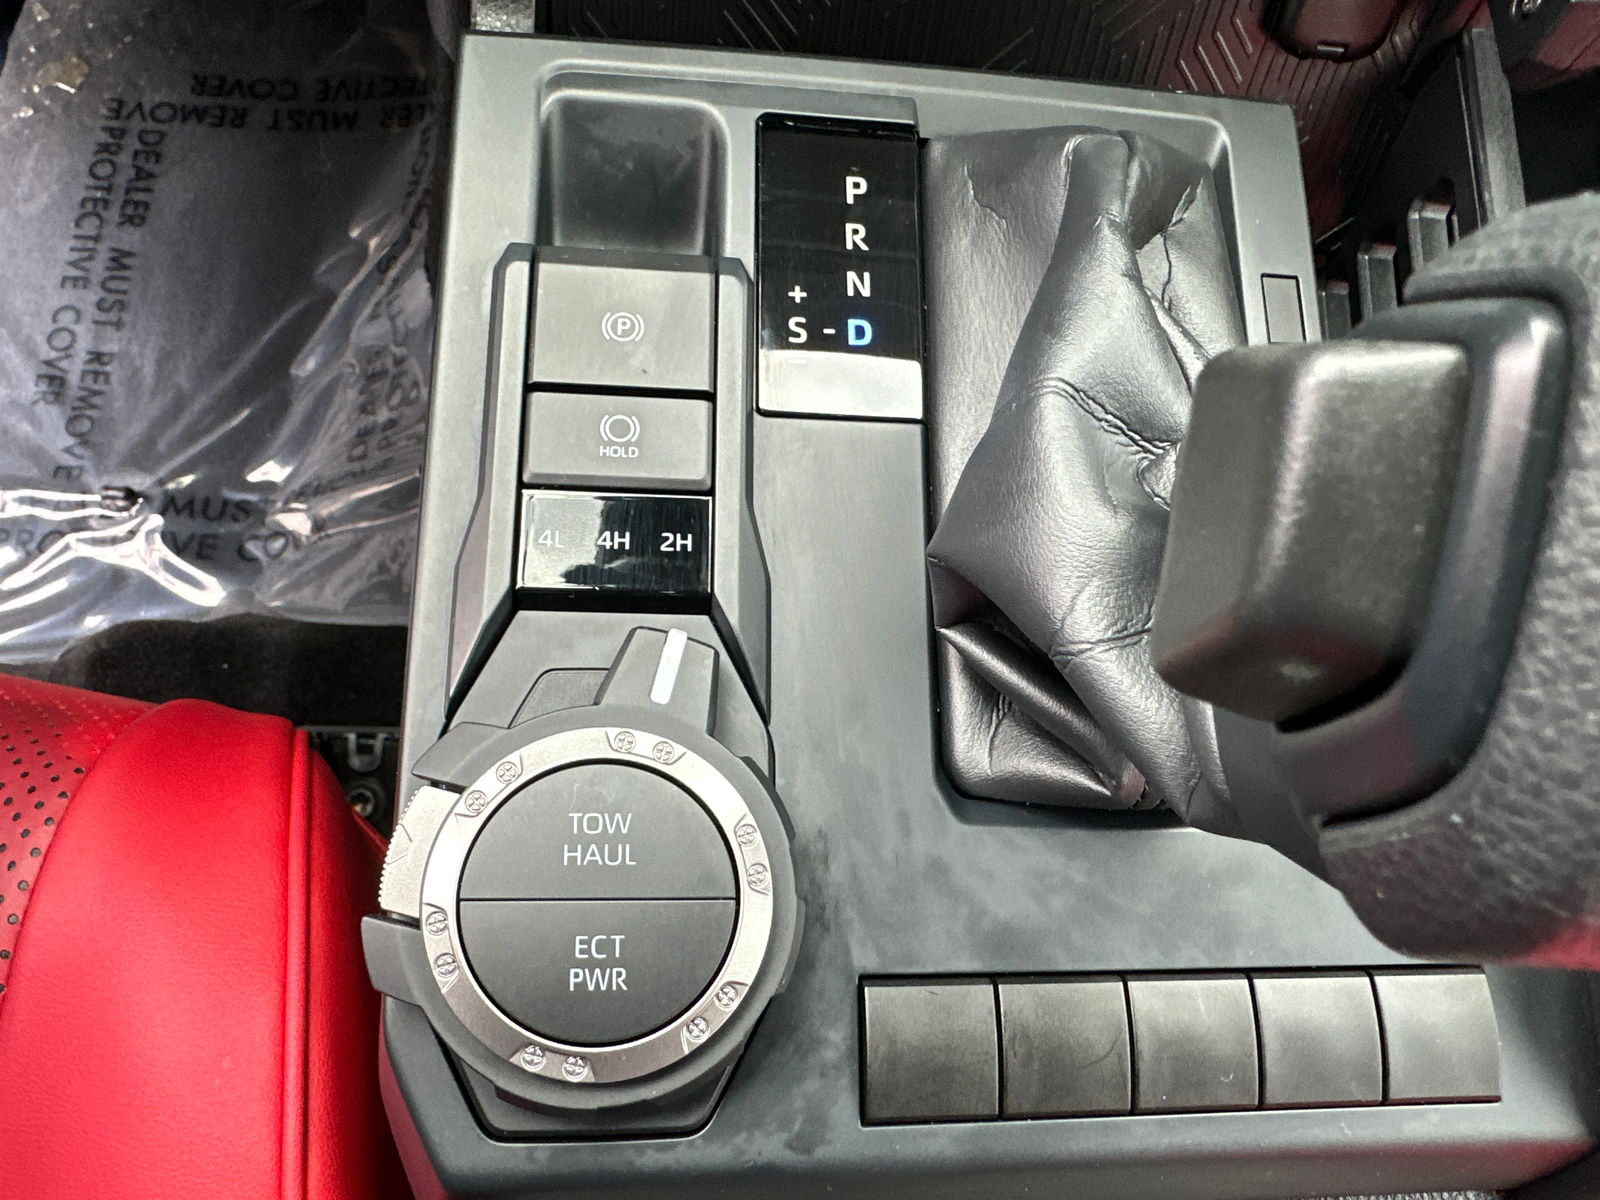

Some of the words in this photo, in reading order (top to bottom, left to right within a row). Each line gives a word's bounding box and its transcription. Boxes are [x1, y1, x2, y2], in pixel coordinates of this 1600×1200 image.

[191, 73, 298, 101] COVER
[104, 97, 248, 129] REMOVE
[267, 108, 358, 132] MUST
[118, 128, 167, 229] DEALER
[845, 175, 868, 205] P
[60, 125, 126, 291] PROTECTIVE
[845, 222, 870, 251] R
[92, 246, 137, 332] MUST
[846, 271, 871, 297] N
[788, 316, 808, 343] S
[847, 318, 872, 346] D
[30, 304, 82, 405] COVER
[53, 350, 113, 481] REMOVE
[600, 445, 639, 458] HOLD
[538, 530, 564, 549] 4L
[597, 531, 631, 551] 4H
[660, 532, 692, 552] 2H
[569, 812, 632, 835] TOW
[563, 844, 637, 867] HAUL
[574, 935, 626, 959] ECT
[569, 967, 628, 992] PWR
